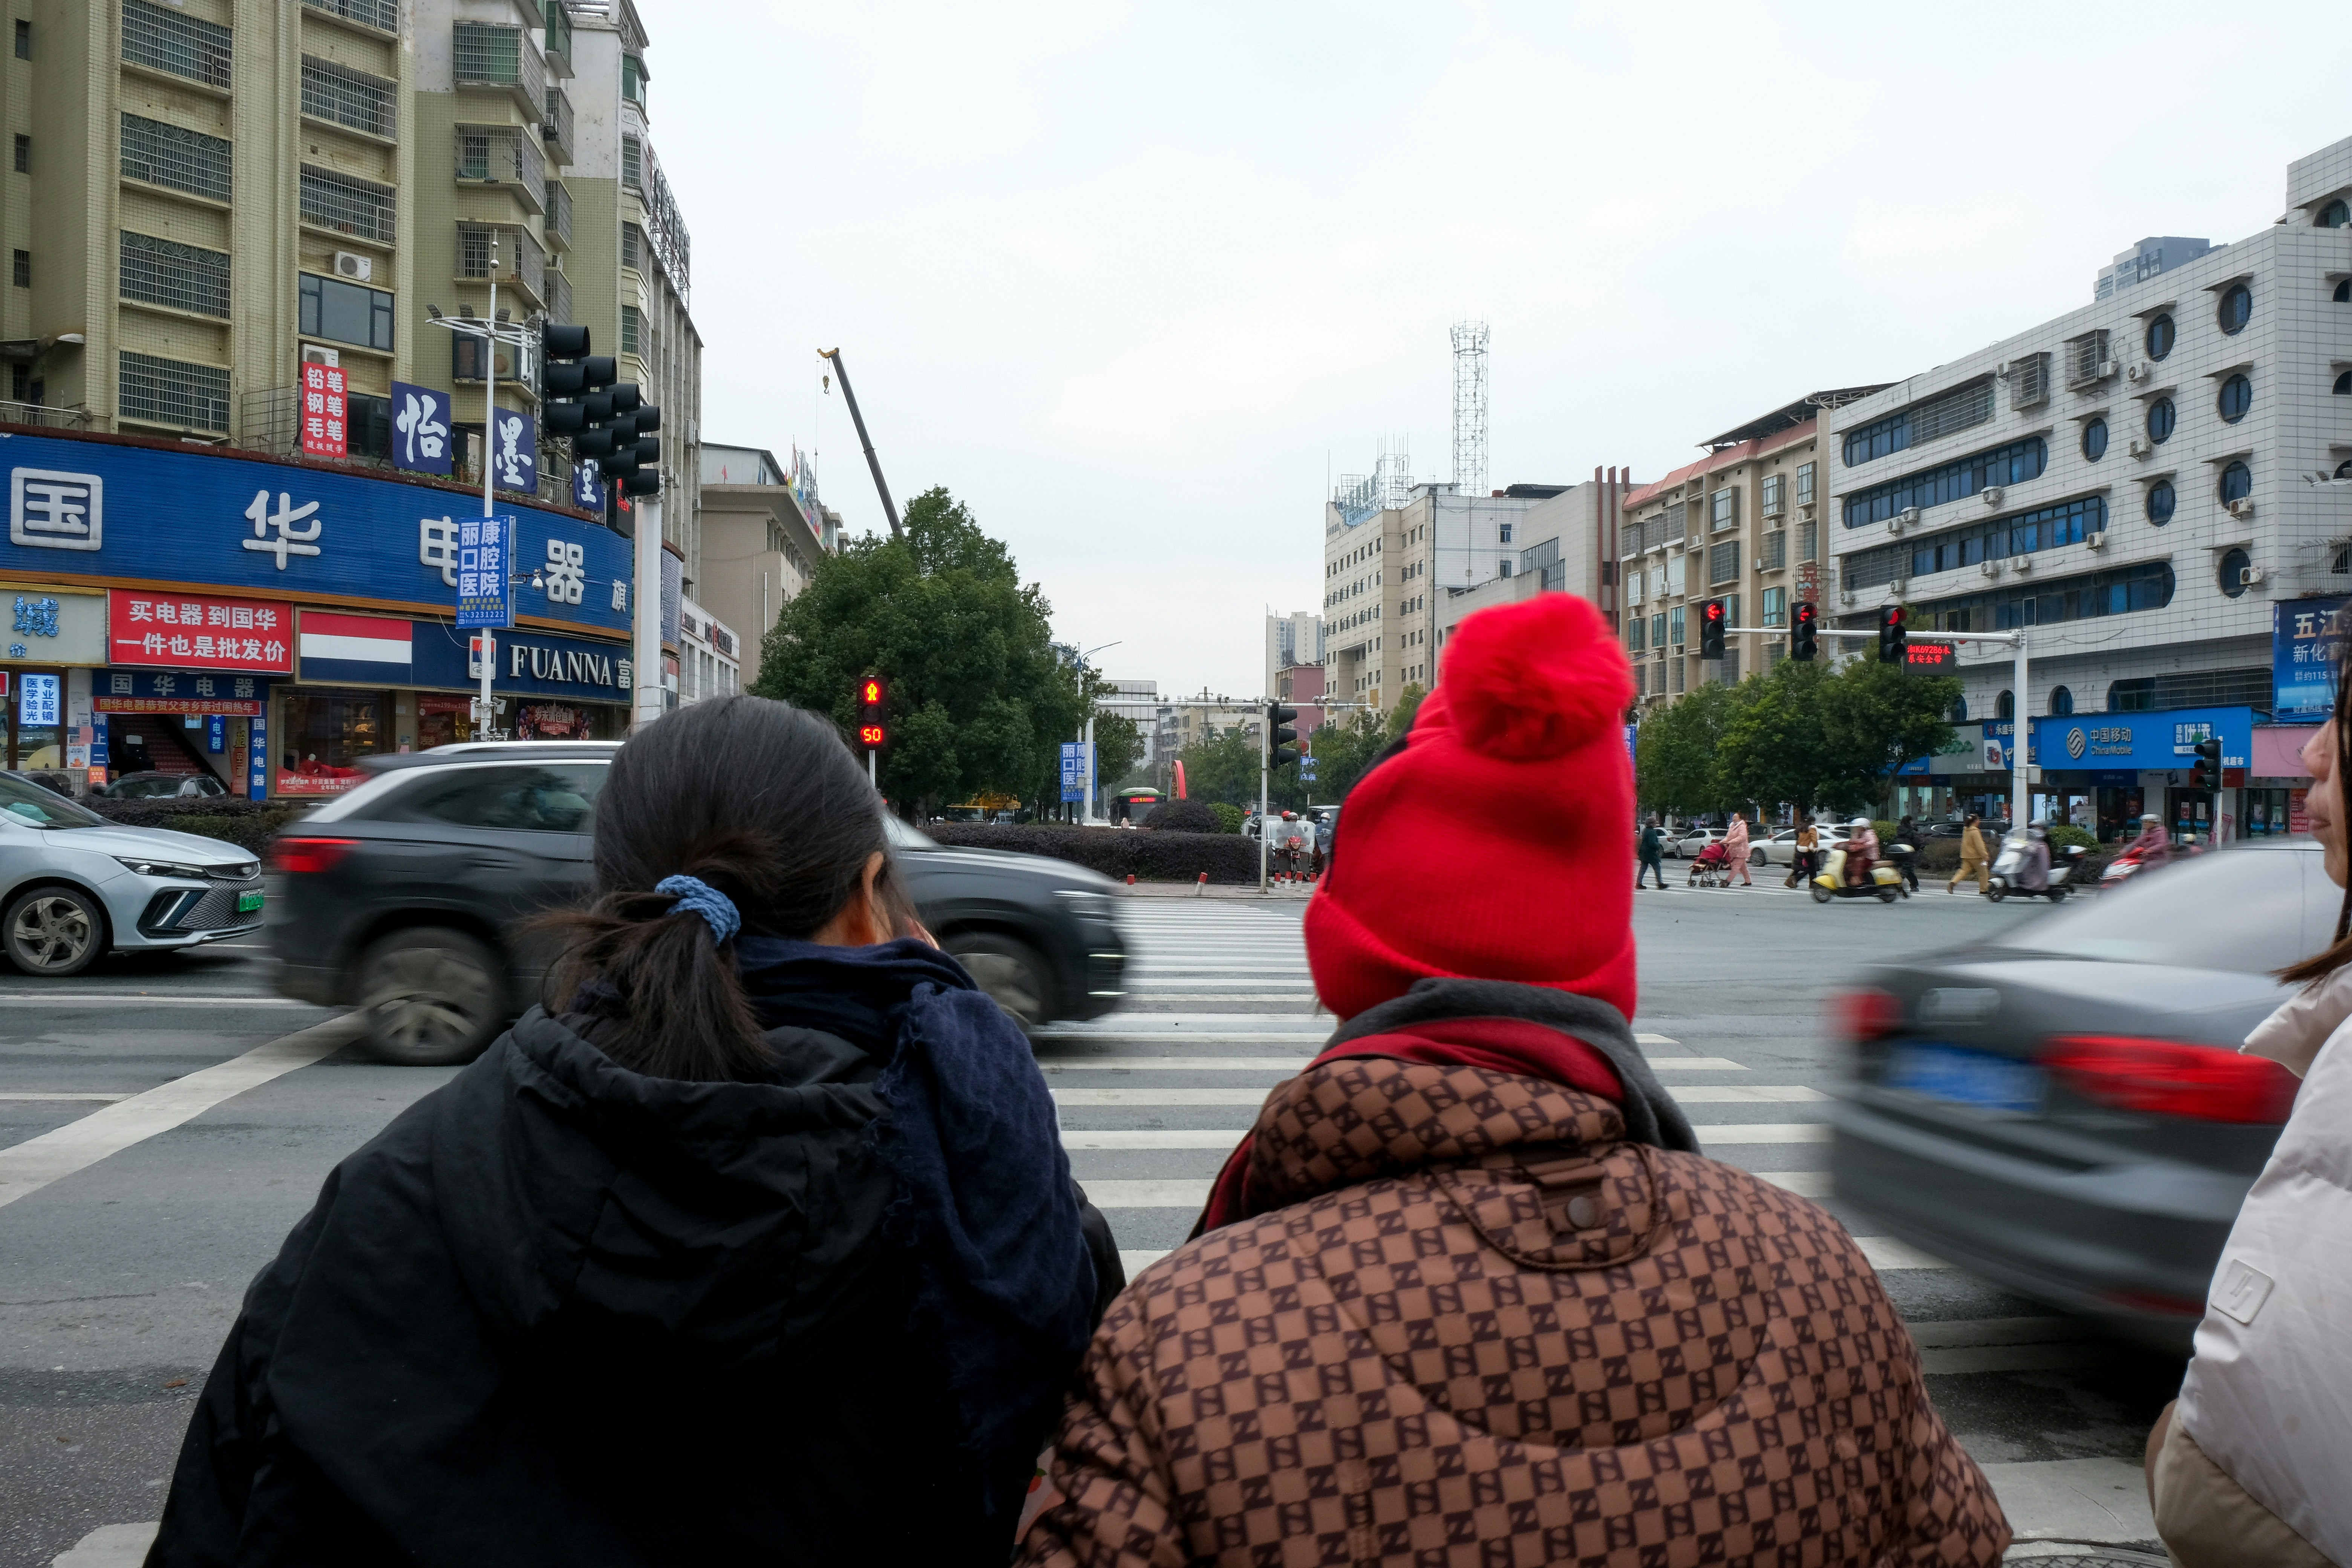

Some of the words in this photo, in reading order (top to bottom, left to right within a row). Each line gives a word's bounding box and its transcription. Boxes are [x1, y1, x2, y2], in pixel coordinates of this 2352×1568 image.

[308, 367, 343, 393] 铅笔
[307, 391, 343, 417] 钢笔
[307, 417, 343, 441] 毛笔
[461, 520, 501, 546] 丽康
[461, 546, 500, 571] 口腔
[460, 571, 499, 596] 医院
[13, 596, 59, 637] 城
[129, 600, 277, 631] 买电器到国华
[116, 632, 286, 662] 一件也是批发价
[510, 645, 613, 686] FUANNA
[111, 674, 255, 698] 国华电器
[26, 678, 38, 721] 医学验光
[42, 678, 54, 721] 专业配镜
[863, 728, 881, 742] 50
[2090, 727, 2132, 742] 中国移动
[254, 719, 266, 786] 国华电器
[2091, 746, 2110, 755] China
